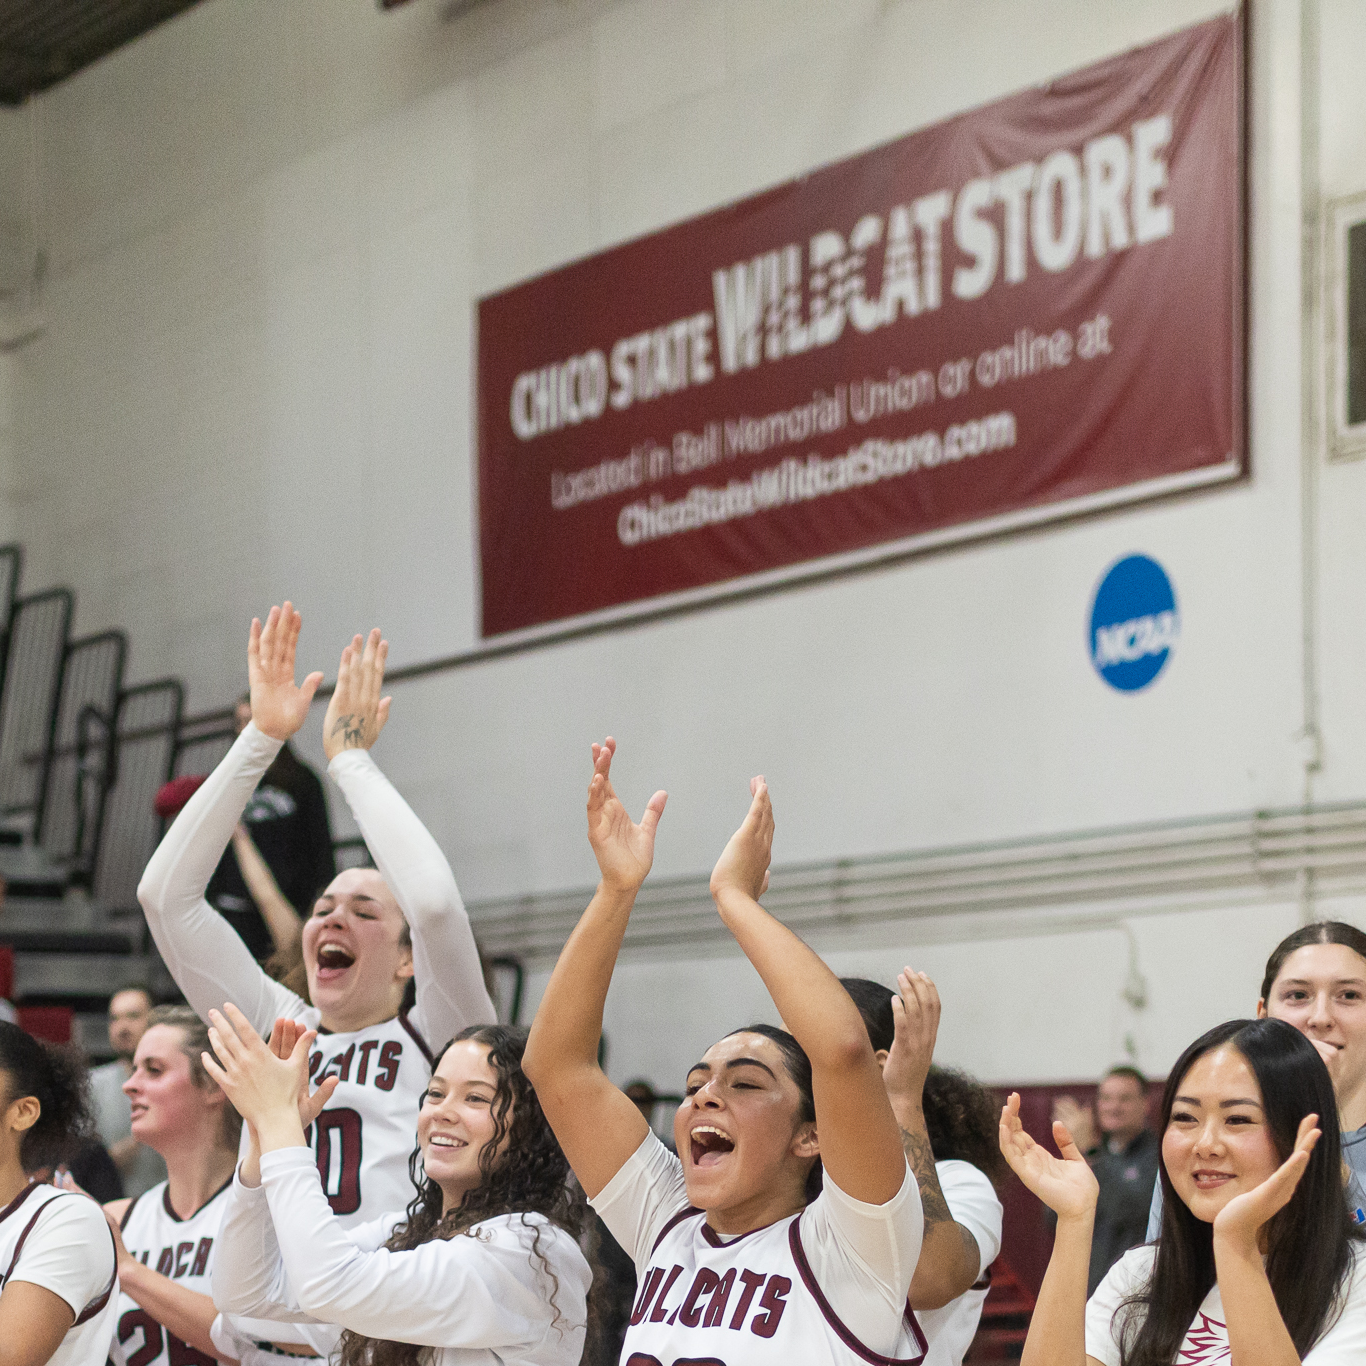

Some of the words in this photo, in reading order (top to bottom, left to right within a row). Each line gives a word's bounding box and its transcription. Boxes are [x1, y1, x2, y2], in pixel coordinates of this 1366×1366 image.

[510, 349, 606, 440] CHICO
[610, 312, 715, 410] STATE
[712, 188, 953, 374] WILDCAT
[951, 113, 1175, 300] STORE
[551, 442, 639, 509] Located
[641, 437, 672, 481] in
[672, 421, 722, 477] Bell
[724, 383, 847, 458] Memorial
[849, 366, 934, 425] Union
[937, 356, 973, 399] or
[975, 327, 1075, 388] online
[1077, 313, 1113, 360] at
[616, 411, 1018, 546] ChicoStateWildcatStore.com
